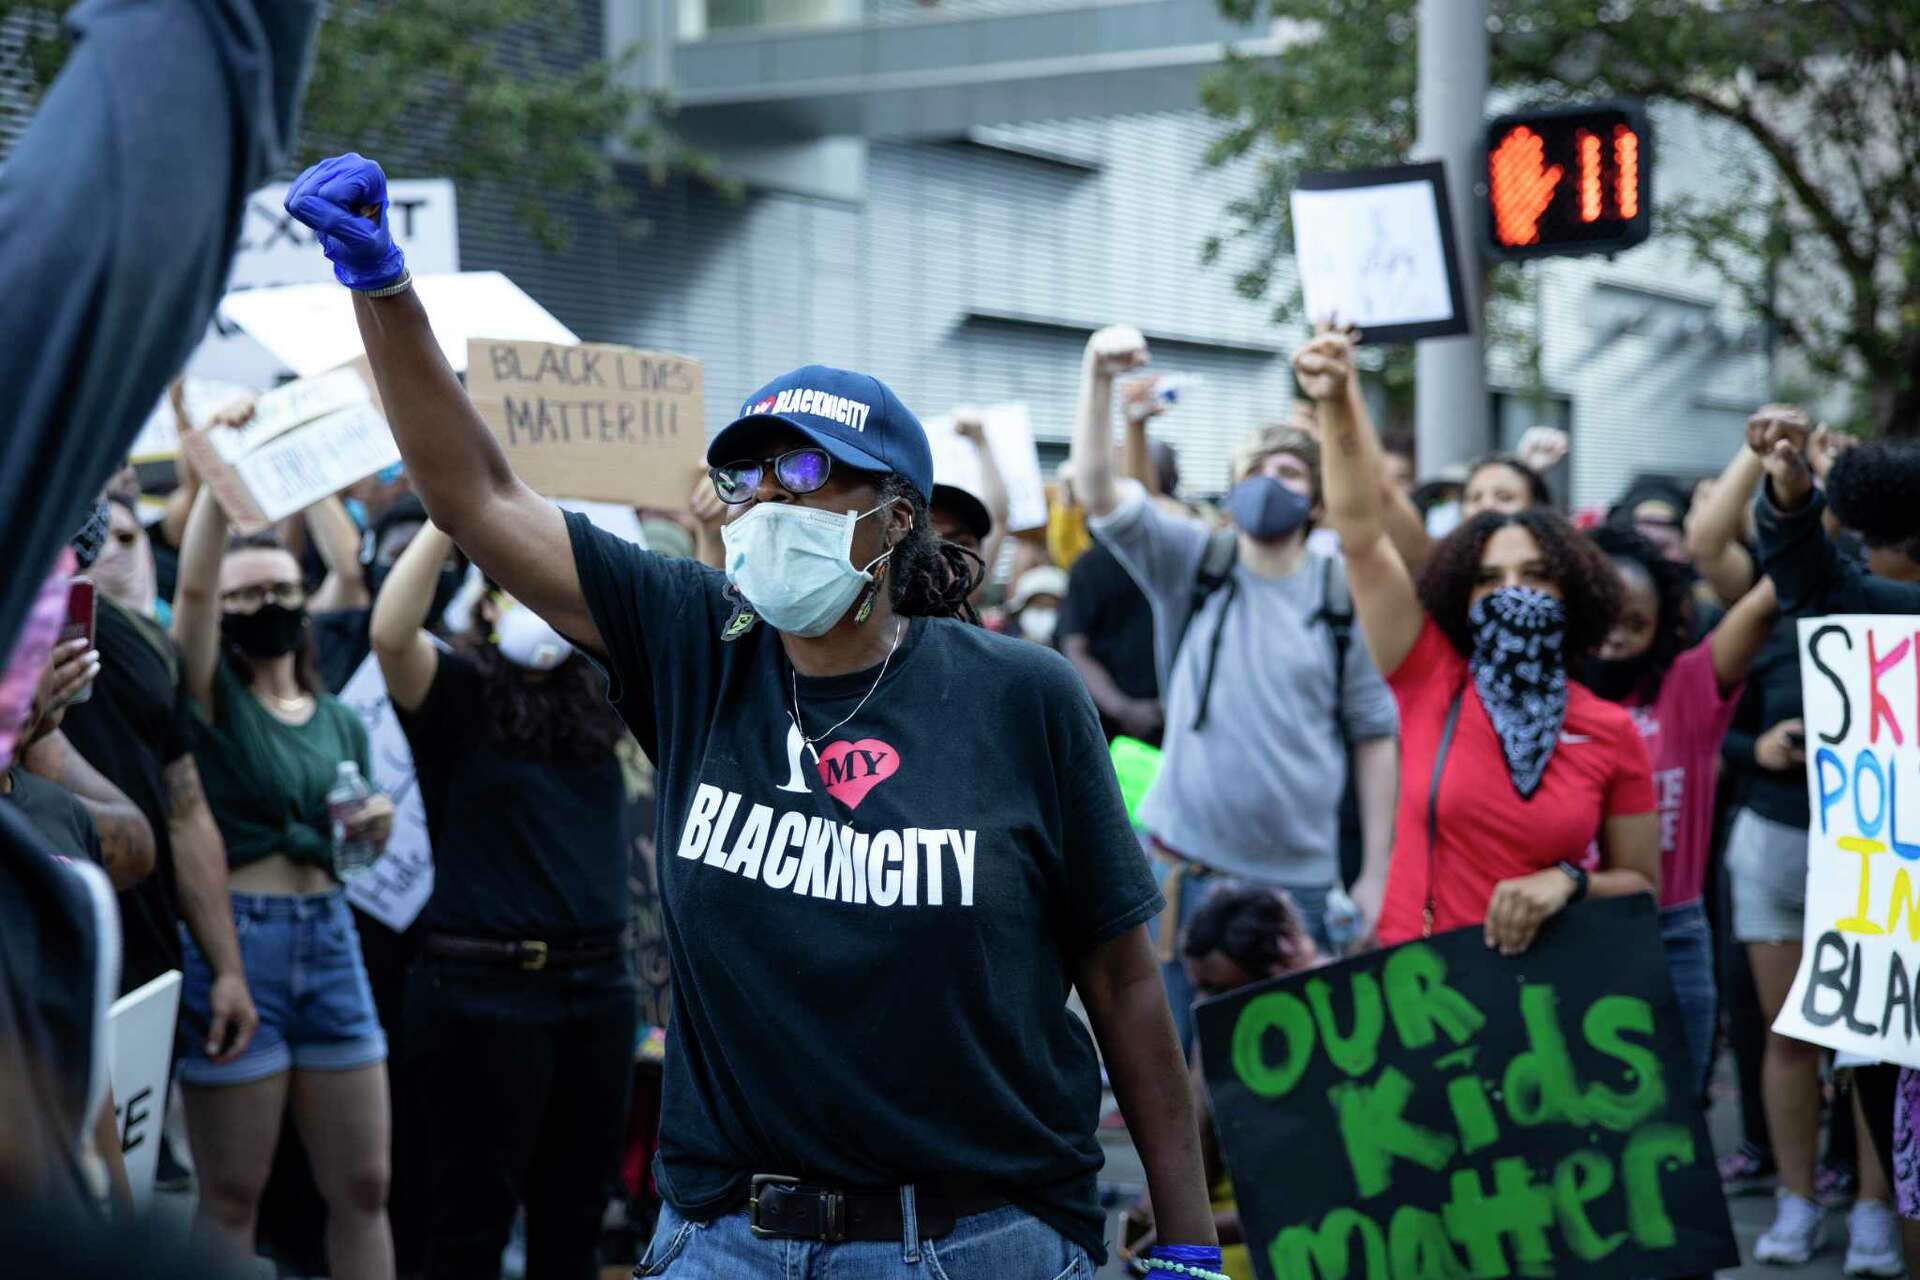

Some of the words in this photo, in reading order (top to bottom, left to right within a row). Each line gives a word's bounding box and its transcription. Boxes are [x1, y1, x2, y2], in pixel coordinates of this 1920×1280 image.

[1577, 125, 1639, 222] 11
[489, 344, 606, 386] BLACK
[772, 388, 870, 432] BLACKNICITY
[826, 749, 888, 787] MY
[677, 783, 977, 906] BLACKNICITY
[1231, 943, 1486, 1098] OUR
